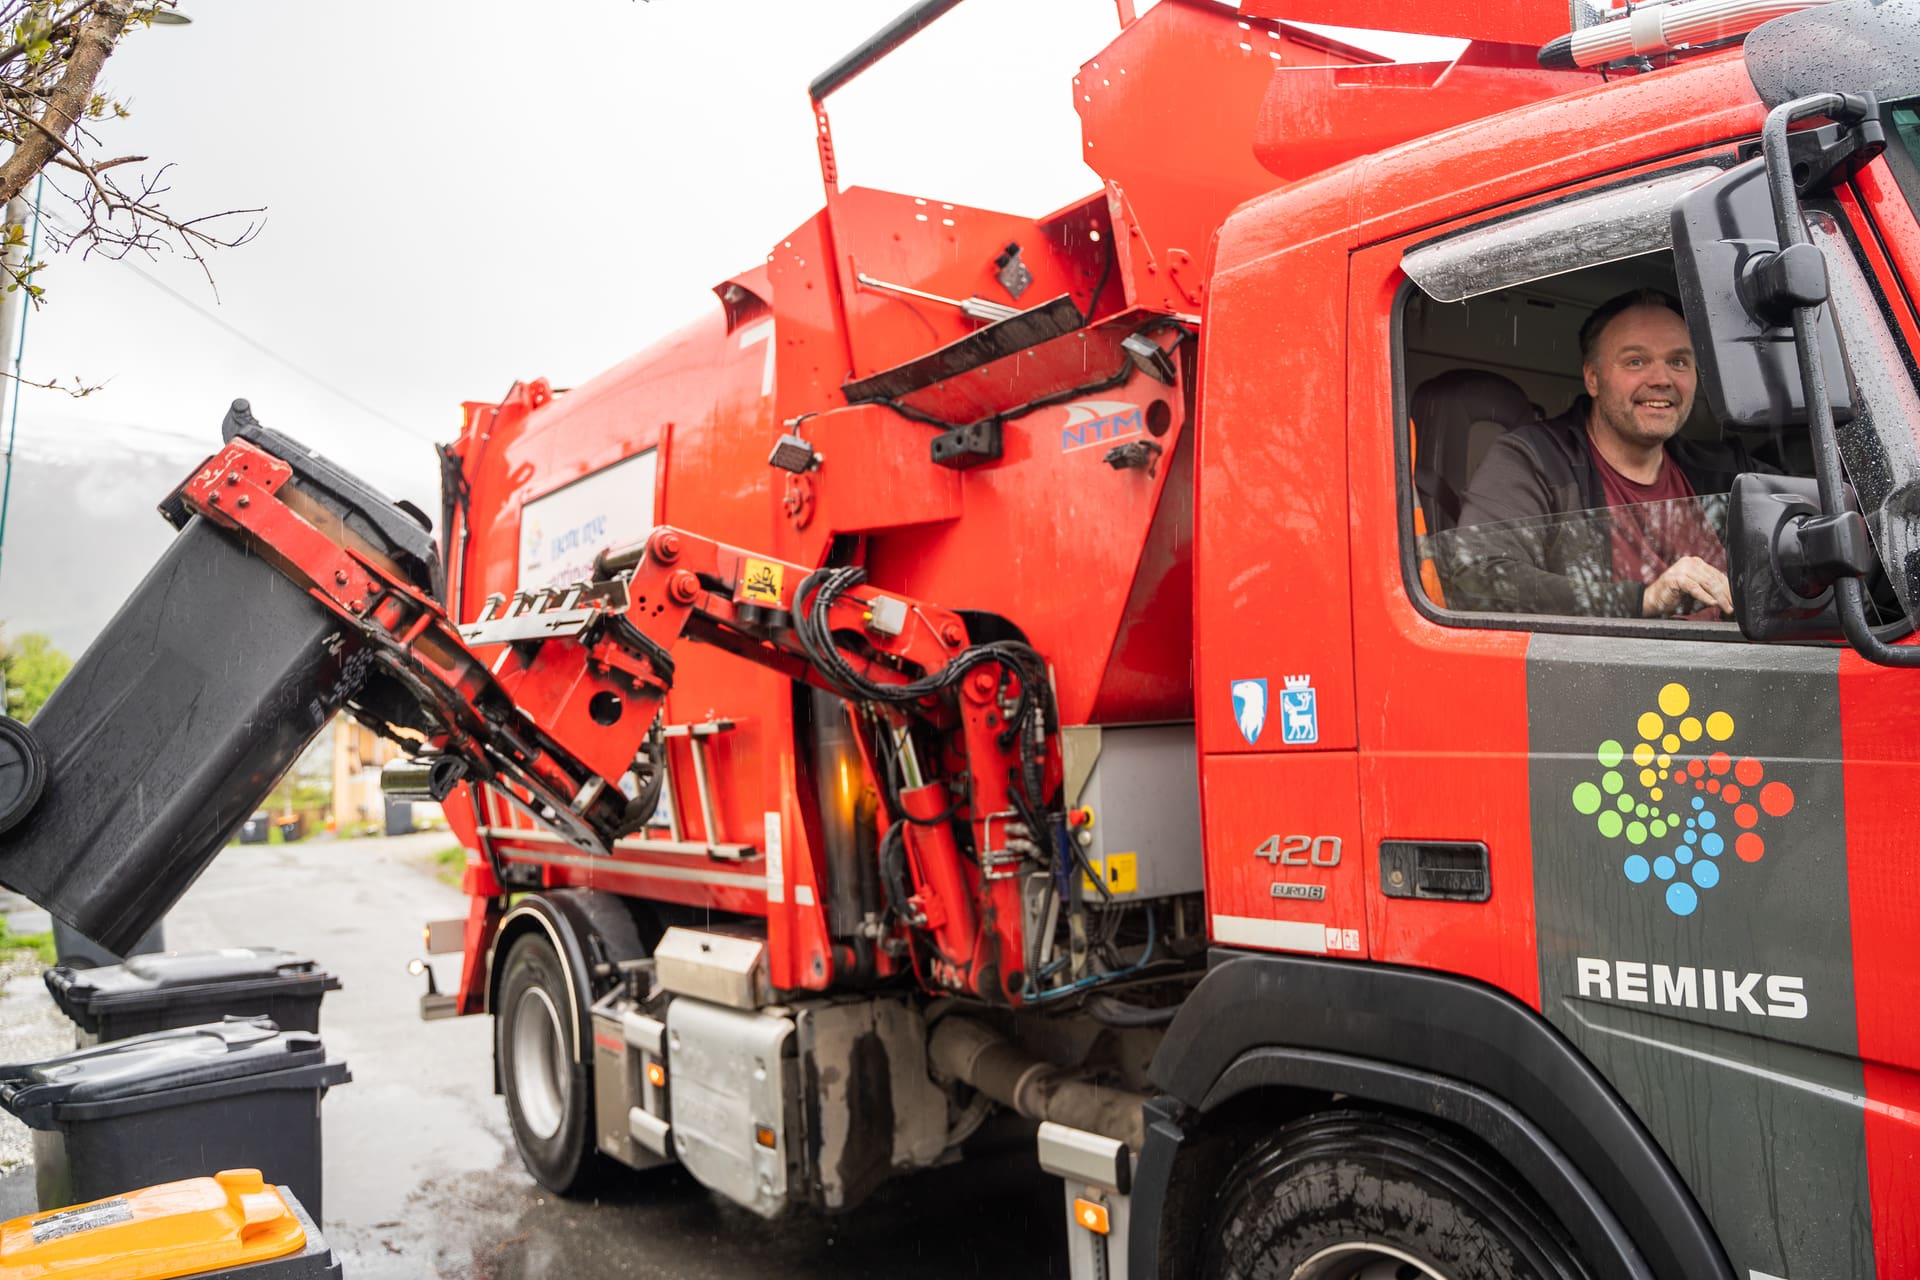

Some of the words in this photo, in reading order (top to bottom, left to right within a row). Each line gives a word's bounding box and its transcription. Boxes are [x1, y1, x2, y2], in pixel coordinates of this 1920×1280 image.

[1063, 410, 1143, 449] NTM
[1254, 834, 1342, 867] 420
[1577, 957, 1808, 1019] REMIKS
